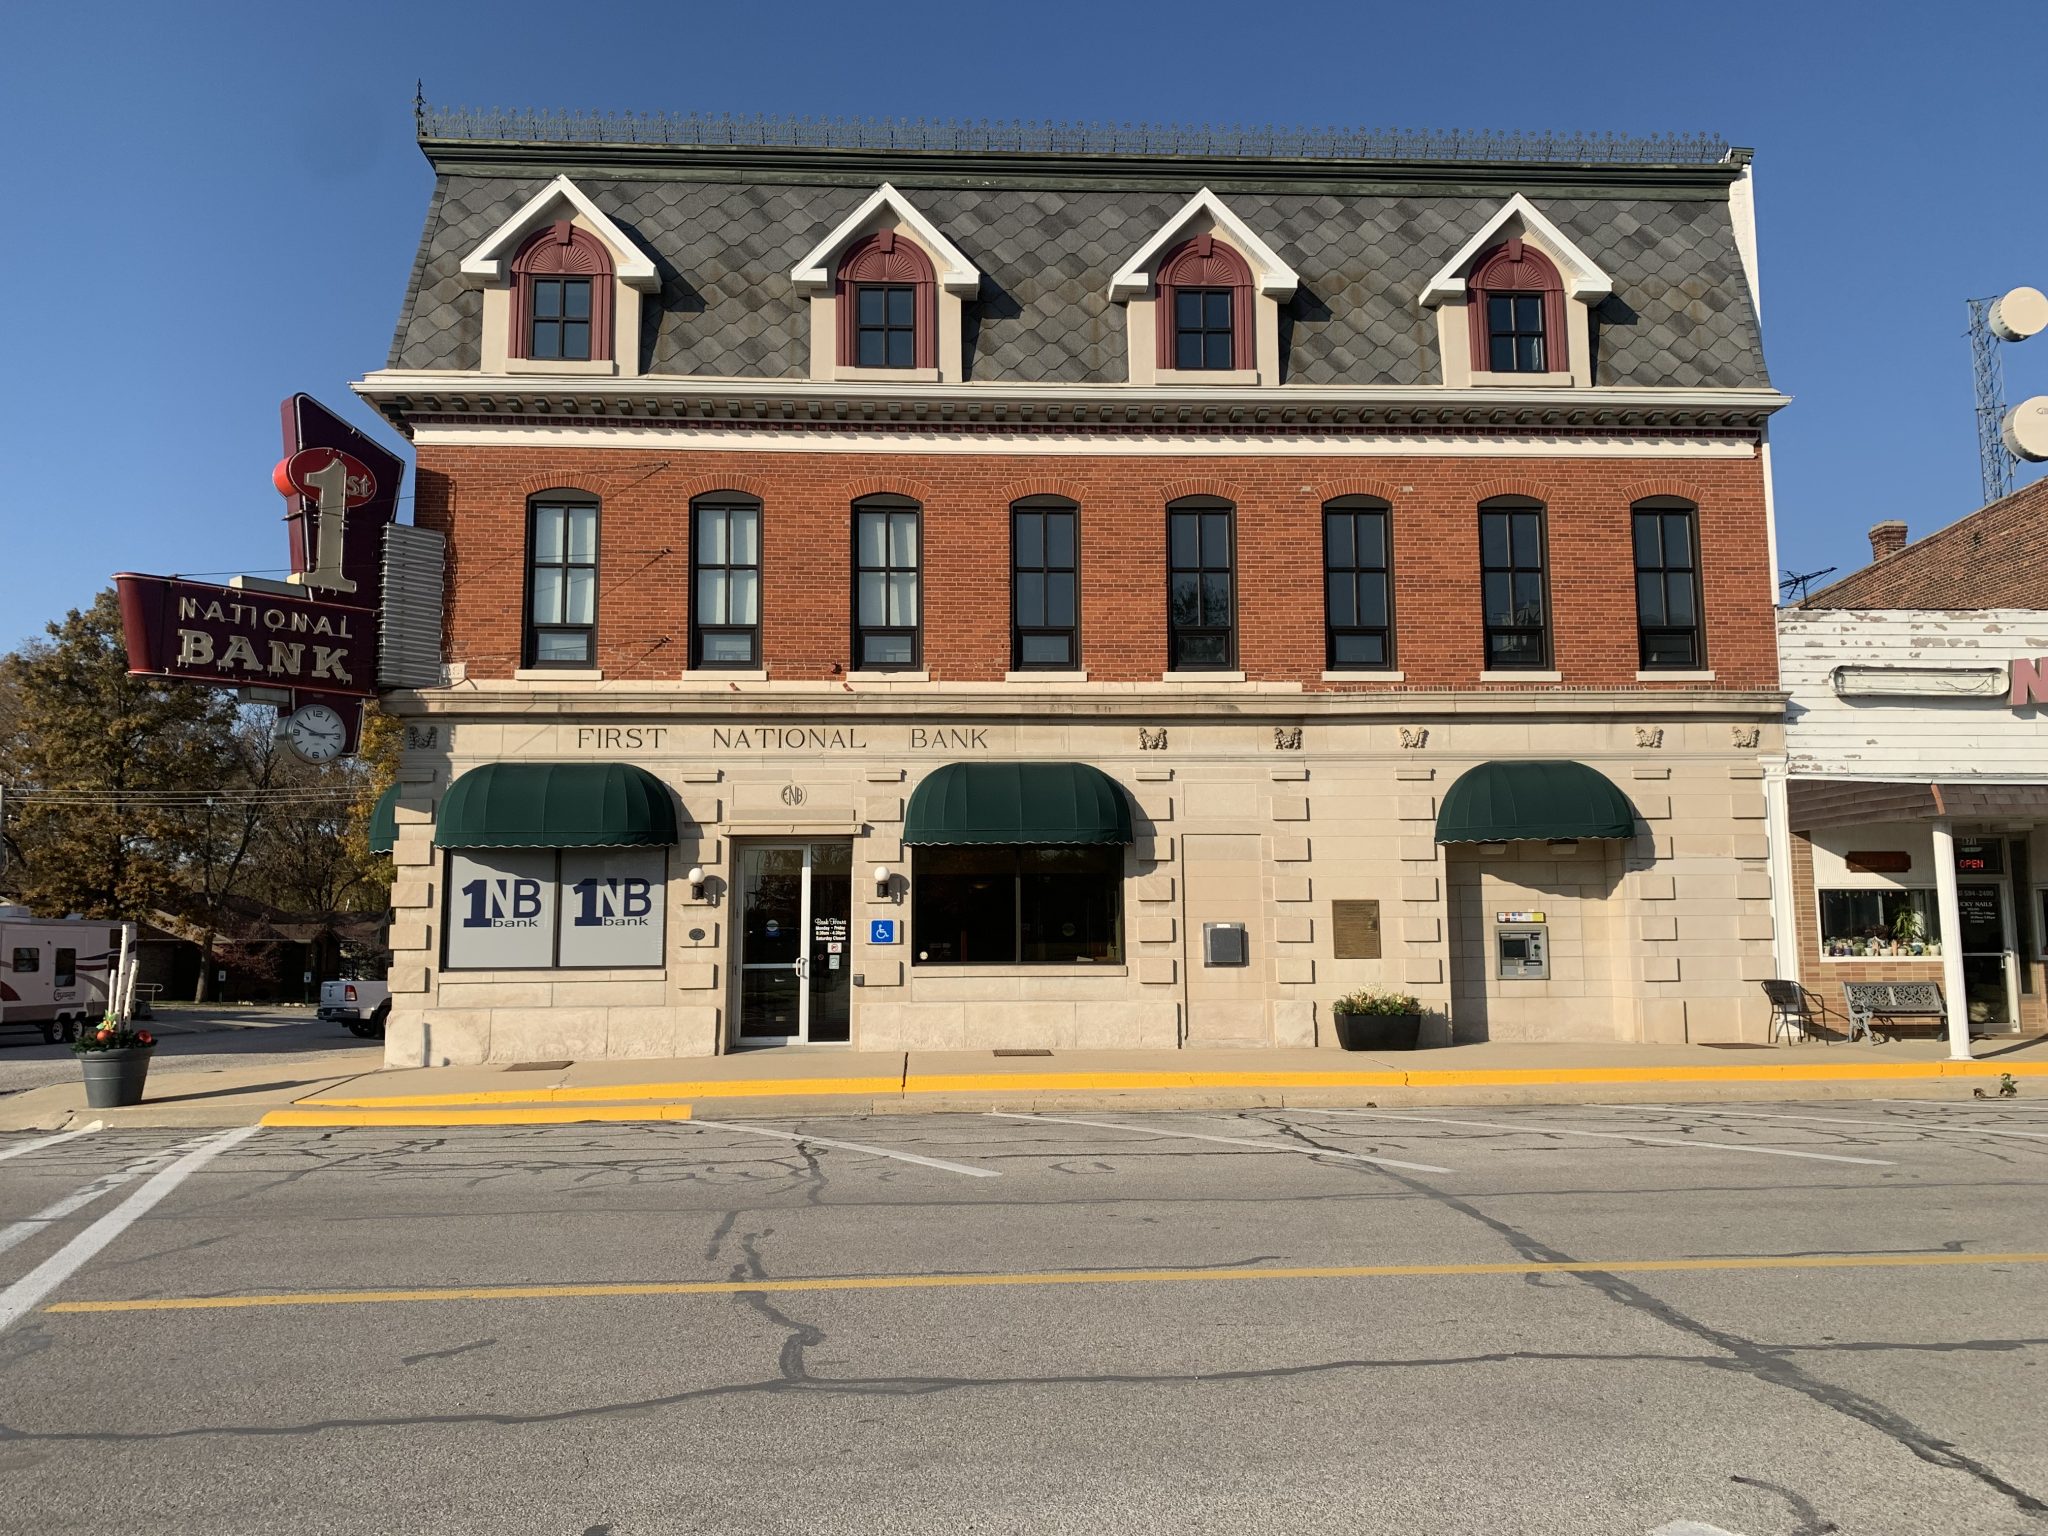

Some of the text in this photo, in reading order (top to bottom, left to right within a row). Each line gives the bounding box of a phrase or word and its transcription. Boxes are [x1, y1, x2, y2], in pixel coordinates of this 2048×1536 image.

[178, 597, 353, 639] NATIONAL
[176, 628, 353, 683] BANK
[577, 728, 989, 749] FIRST NATIONAL BANK
[1959, 859, 1984, 869] OPEN
[462, 879, 542, 928] 1NB
[573, 877, 652, 926] 1NB
[493, 918, 539, 928] bank
[603, 917, 649, 926] bank
